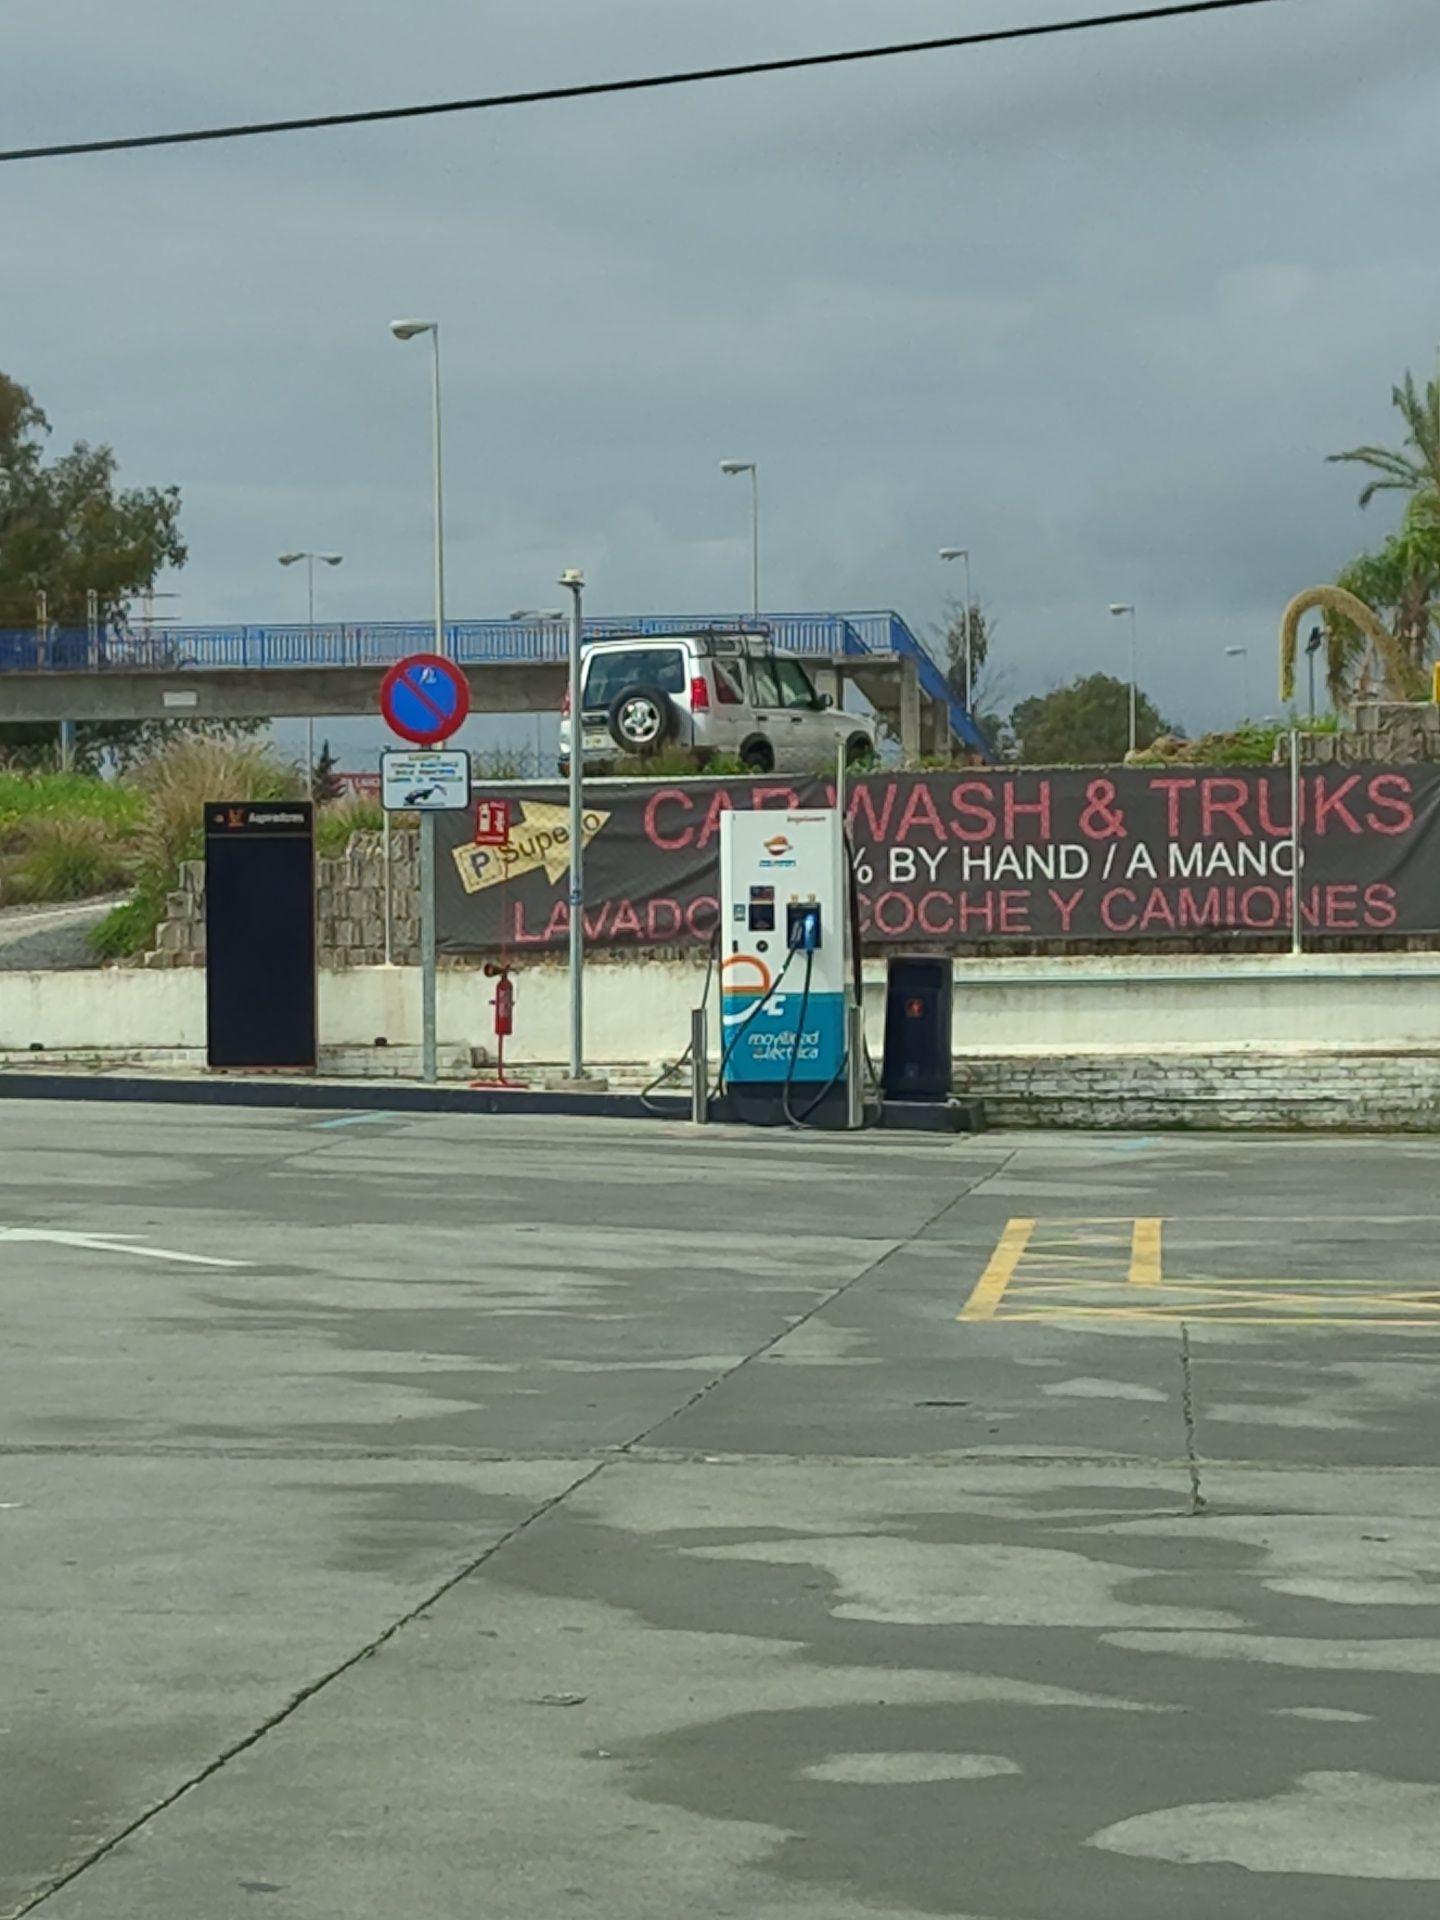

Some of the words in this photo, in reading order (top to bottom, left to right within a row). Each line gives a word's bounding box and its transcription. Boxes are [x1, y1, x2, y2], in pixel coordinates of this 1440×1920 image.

[1078, 778, 1128, 840] &
[1150, 774, 1415, 837] TRUKS
[889, 846, 949, 883] BY
[962, 843, 1090, 882] HAND
[1125, 842, 1158, 879] A
[1167, 840, 1305, 878] MANO
[1048, 887, 1085, 932] Y
[1100, 882, 1399, 933] CAMIONES
